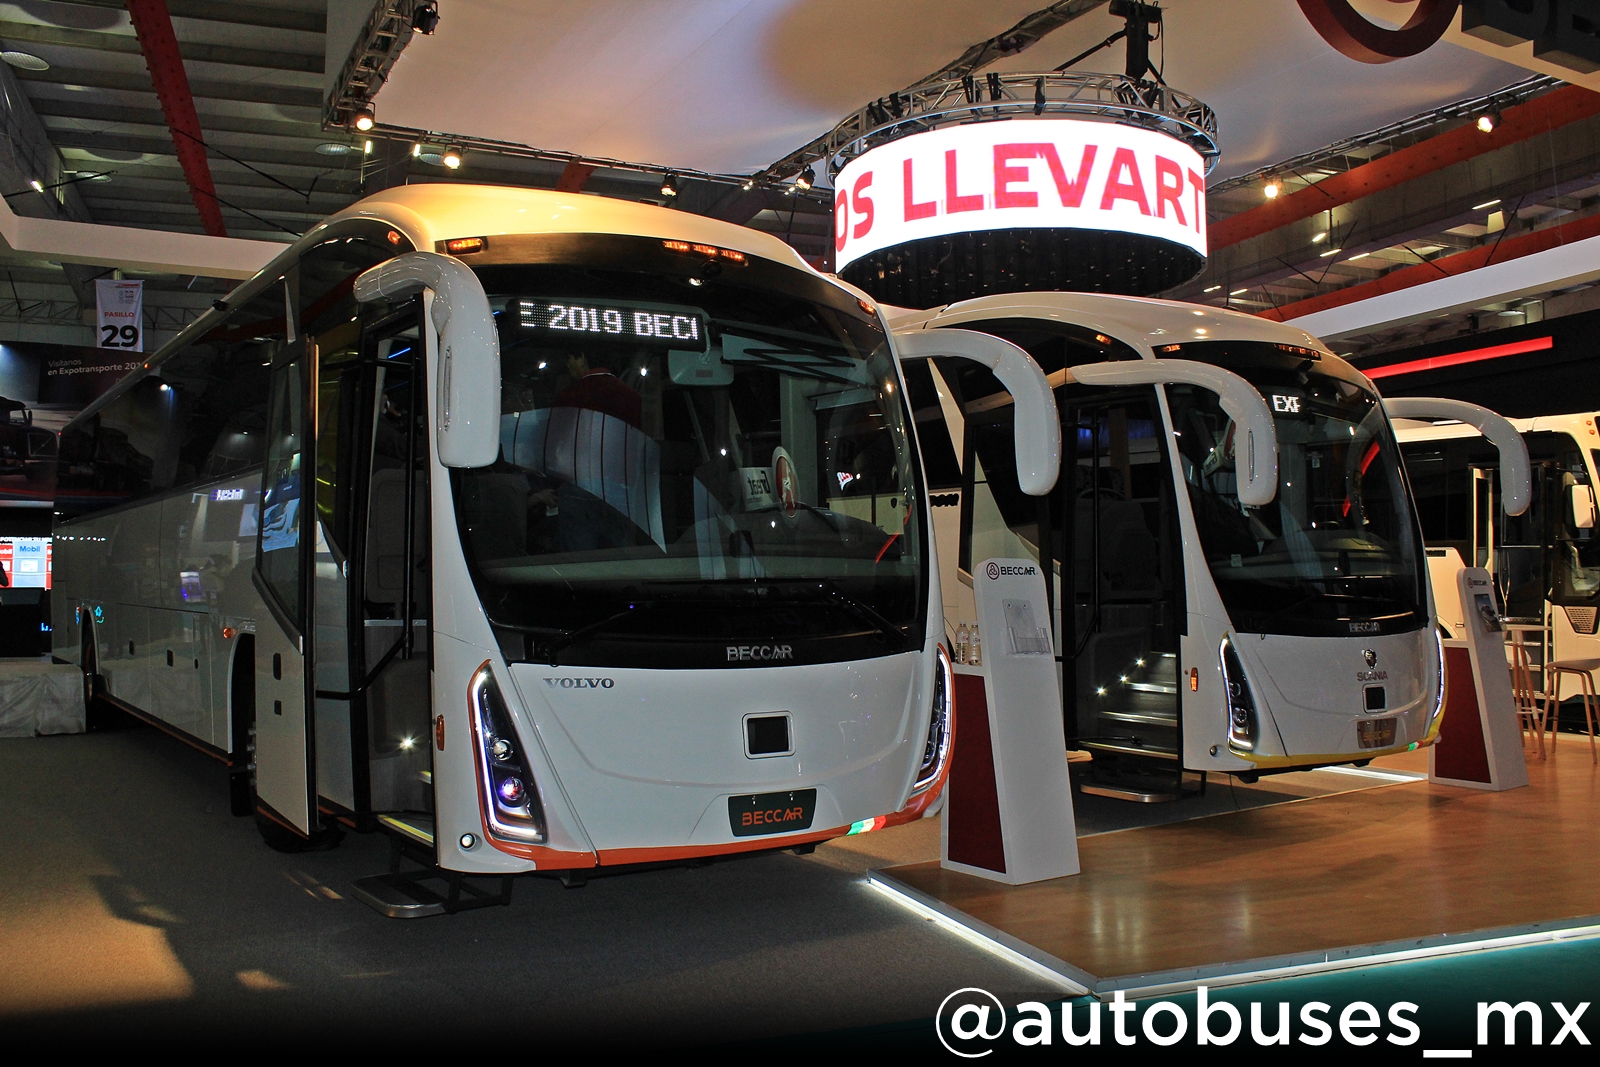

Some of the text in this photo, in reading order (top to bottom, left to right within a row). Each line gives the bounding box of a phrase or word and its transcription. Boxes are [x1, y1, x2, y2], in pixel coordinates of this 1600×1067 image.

[835, 142, 1204, 252] OS LLEVART
[549, 304, 623, 333] 2019
[101, 325, 138, 347] 29
[59, 364, 123, 376] Expotransporte
[19, 545, 41, 553] Mobil
[1000, 566, 1036, 575] BECCAR
[1348, 622, 1381, 633] BECCAR
[727, 645, 793, 662] BECCAR
[1356, 671, 1389, 682] SCANIA
[543, 677, 615, 689] VOLVO
[741, 806, 804, 827] BECCAR
